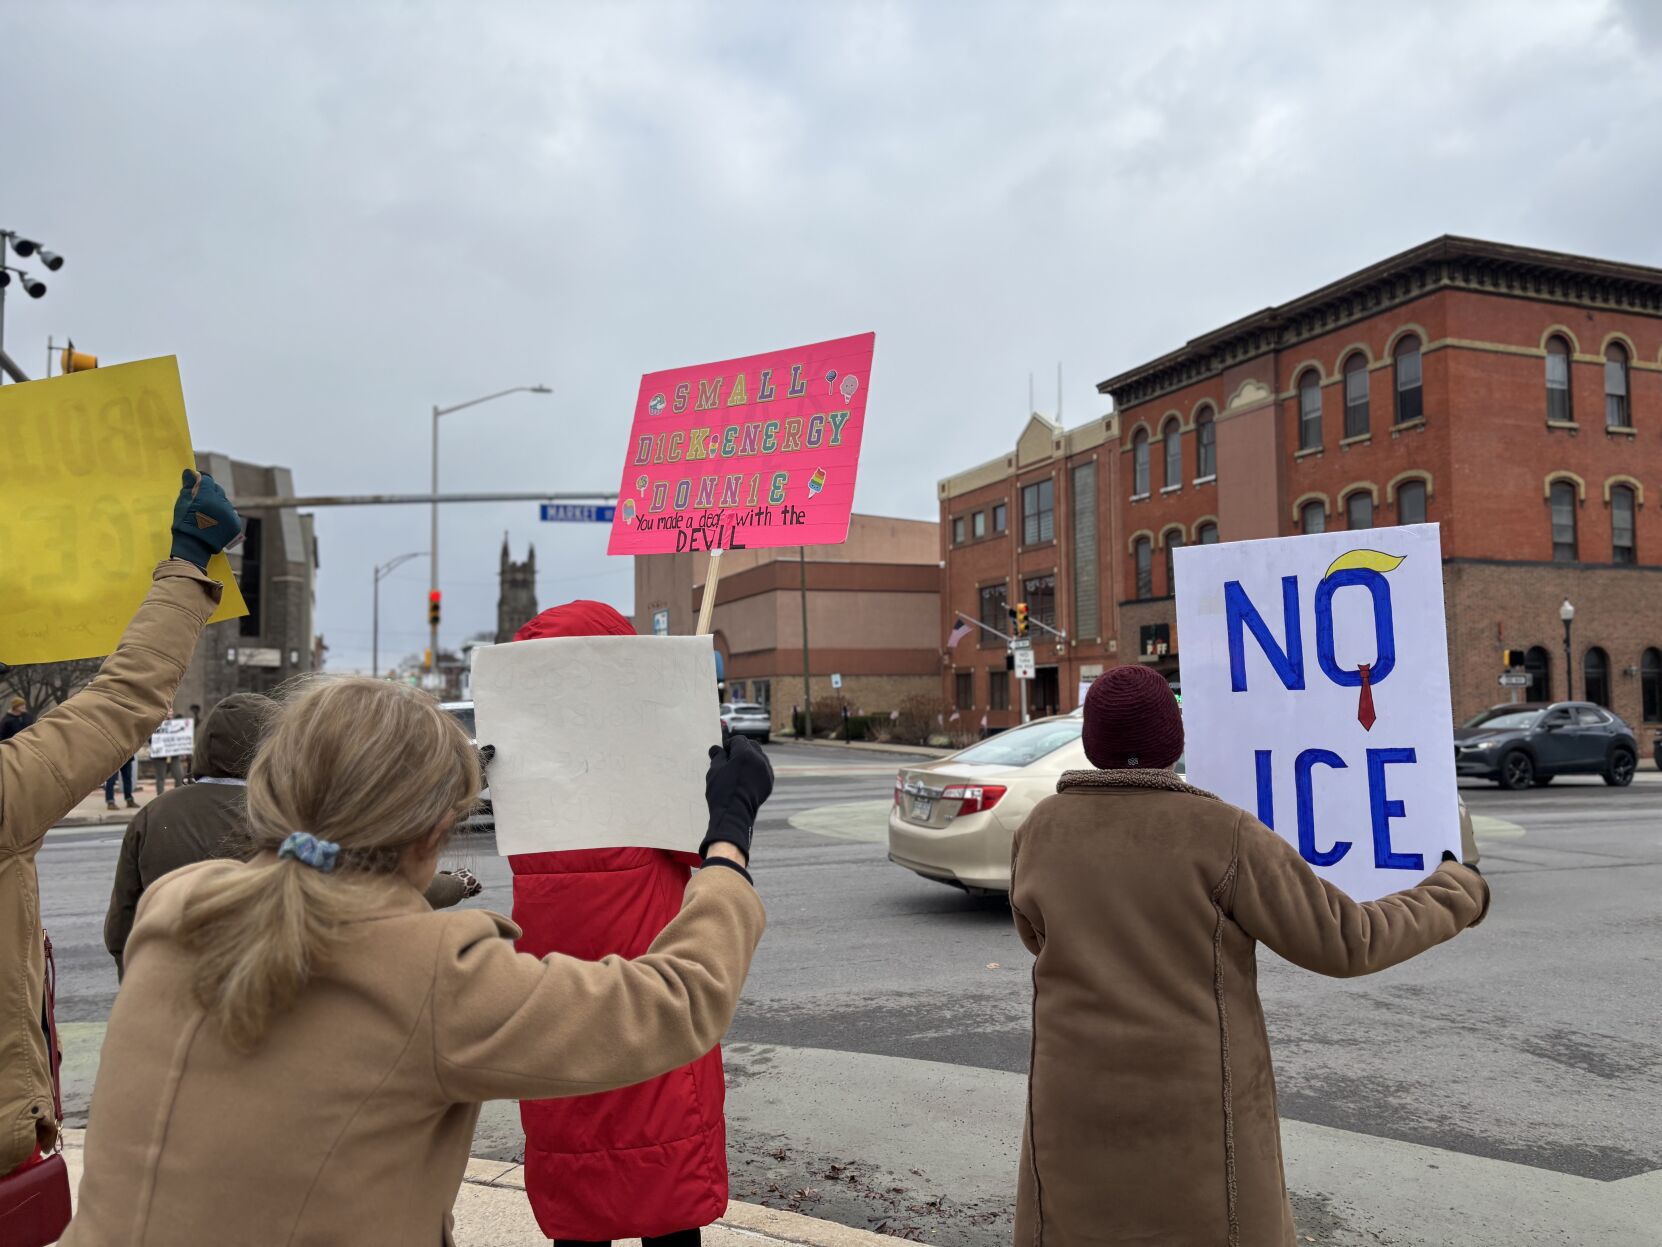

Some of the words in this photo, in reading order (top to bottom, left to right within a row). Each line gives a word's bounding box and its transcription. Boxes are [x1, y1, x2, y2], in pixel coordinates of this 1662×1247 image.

[672, 363, 807, 413] SMALL
[721, 411, 850, 457] ENERGY
[548, 505, 596, 520] MARKET
[636, 514, 653, 531] You
[657, 512, 683, 529] made
[686, 517, 693, 528] a
[735, 506, 771, 526] with
[781, 505, 806, 526] the
[676, 525, 745, 552] DEVIL
[1224, 567, 1396, 692] NO
[1254, 747, 1424, 870] ICE
